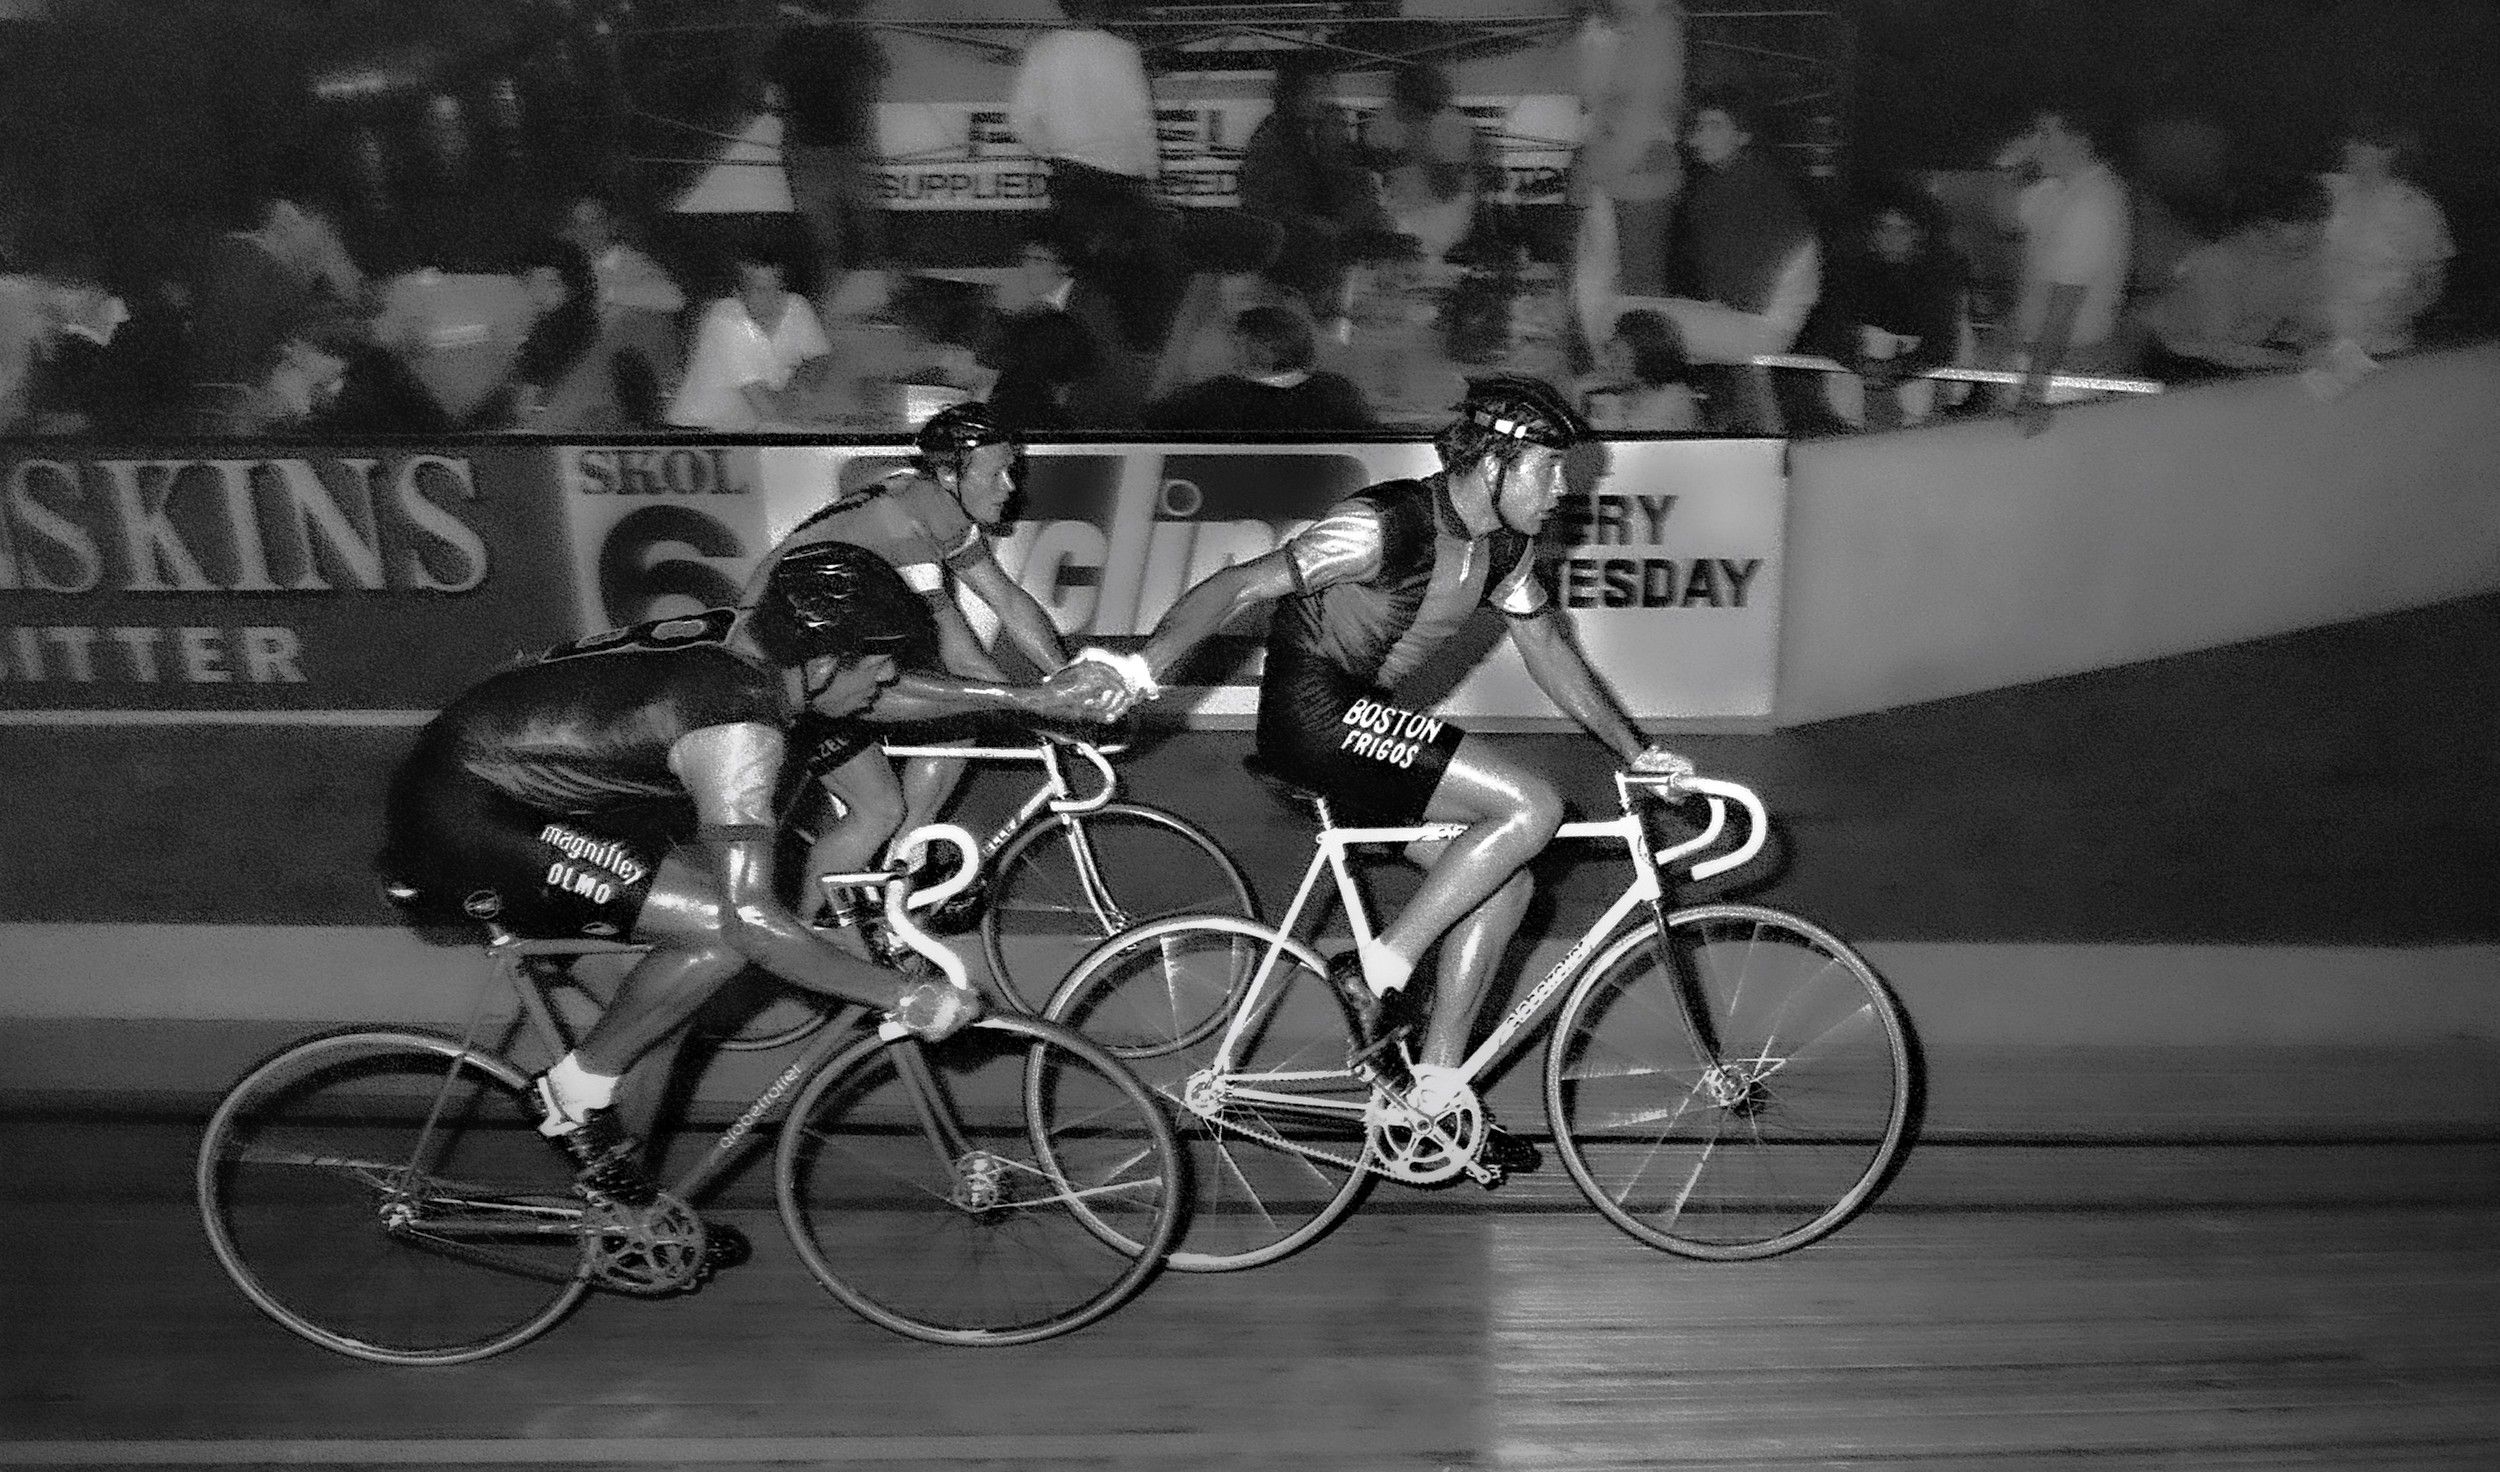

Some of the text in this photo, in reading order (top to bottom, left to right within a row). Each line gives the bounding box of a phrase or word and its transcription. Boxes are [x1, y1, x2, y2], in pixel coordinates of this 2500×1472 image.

[875, 173, 1049, 200] SUPPLIED
[578, 448, 750, 496] SKOL
[0, 457, 487, 592] SKINS
[0, 626, 308, 682] ITTER
[1342, 699, 1444, 744] BOSTON
[1340, 730, 1420, 769] FRIGOS
[546, 862, 612, 905] OLMO
